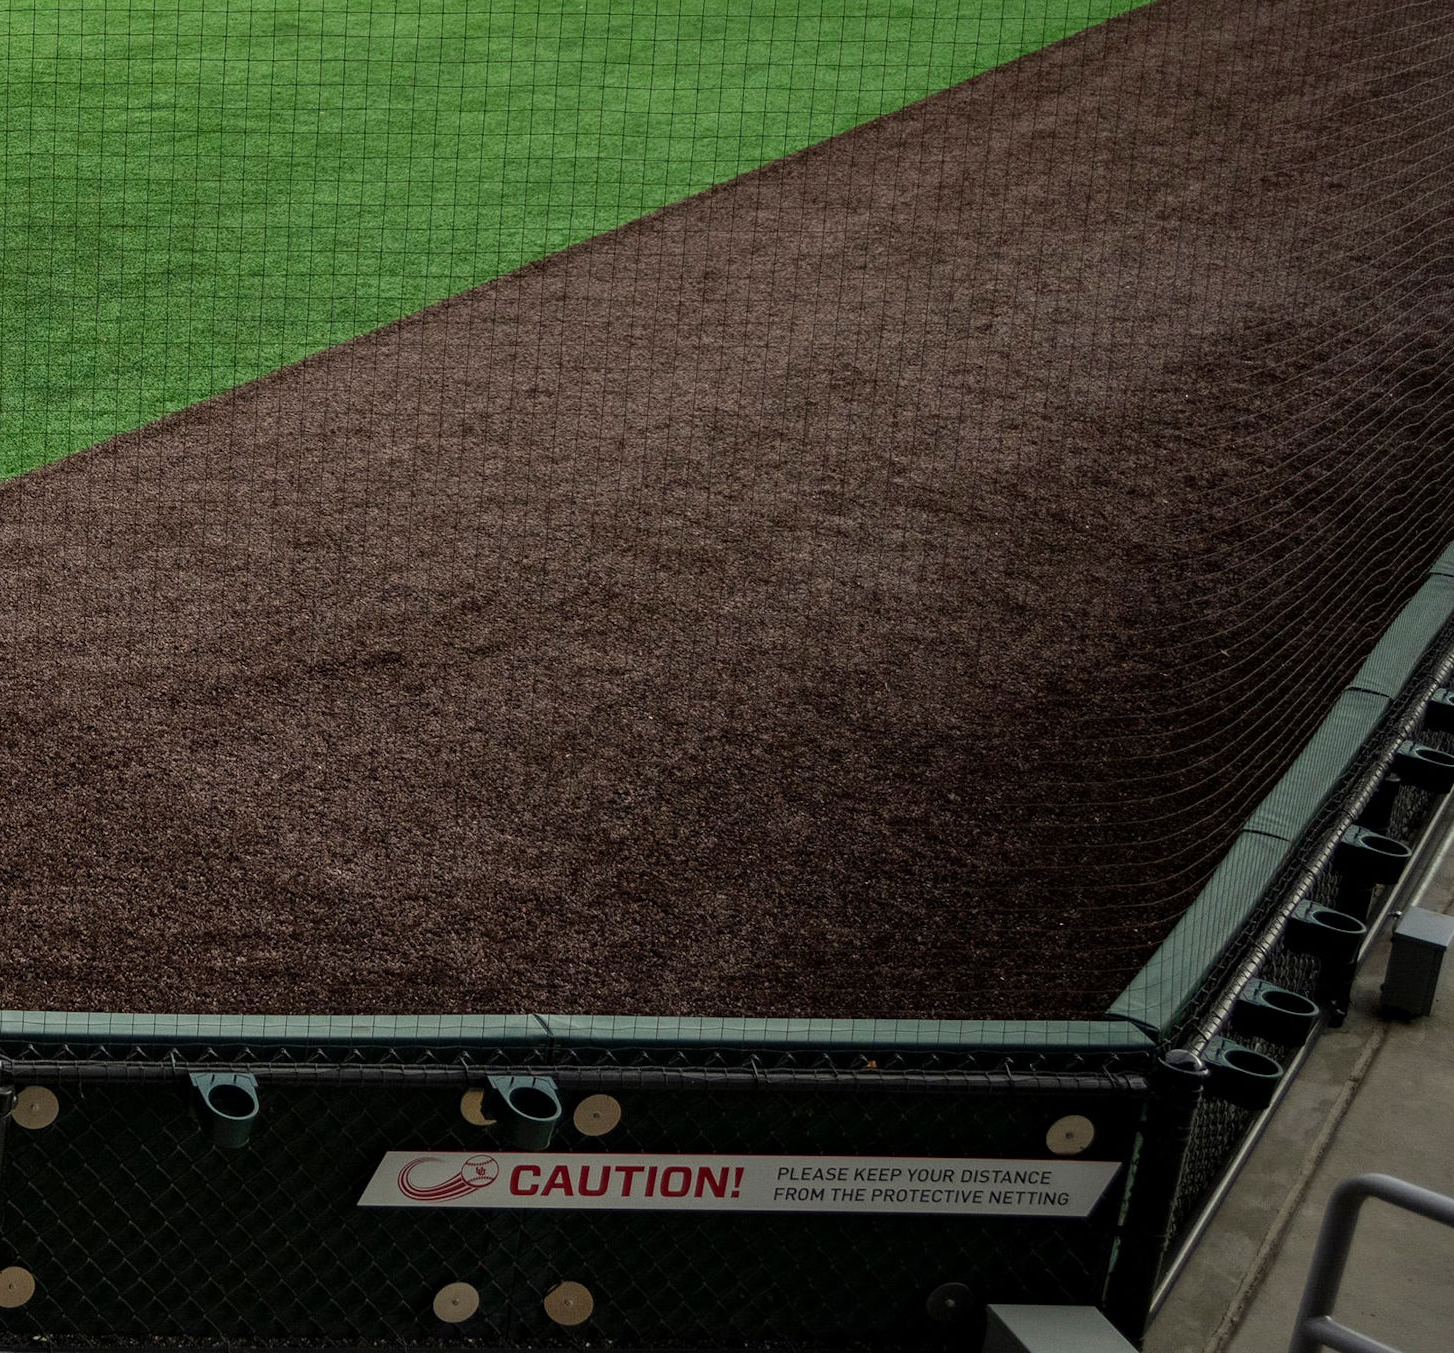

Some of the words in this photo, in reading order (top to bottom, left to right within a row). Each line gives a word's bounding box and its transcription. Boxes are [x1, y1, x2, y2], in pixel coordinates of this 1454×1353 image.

[509, 1164, 745, 1198] CAUTION!
[776, 1166, 849, 1182] PLEASE
[854, 1167, 902, 1183] KEEP
[907, 1168, 956, 1184] YOUR
[960, 1169, 1052, 1185] DISTANCE
[773, 1187, 825, 1201] FROM
[830, 1188, 868, 1202] THE
[871, 1189, 984, 1204] PROTECTIVE
[988, 1190, 1069, 1206] NETTING
